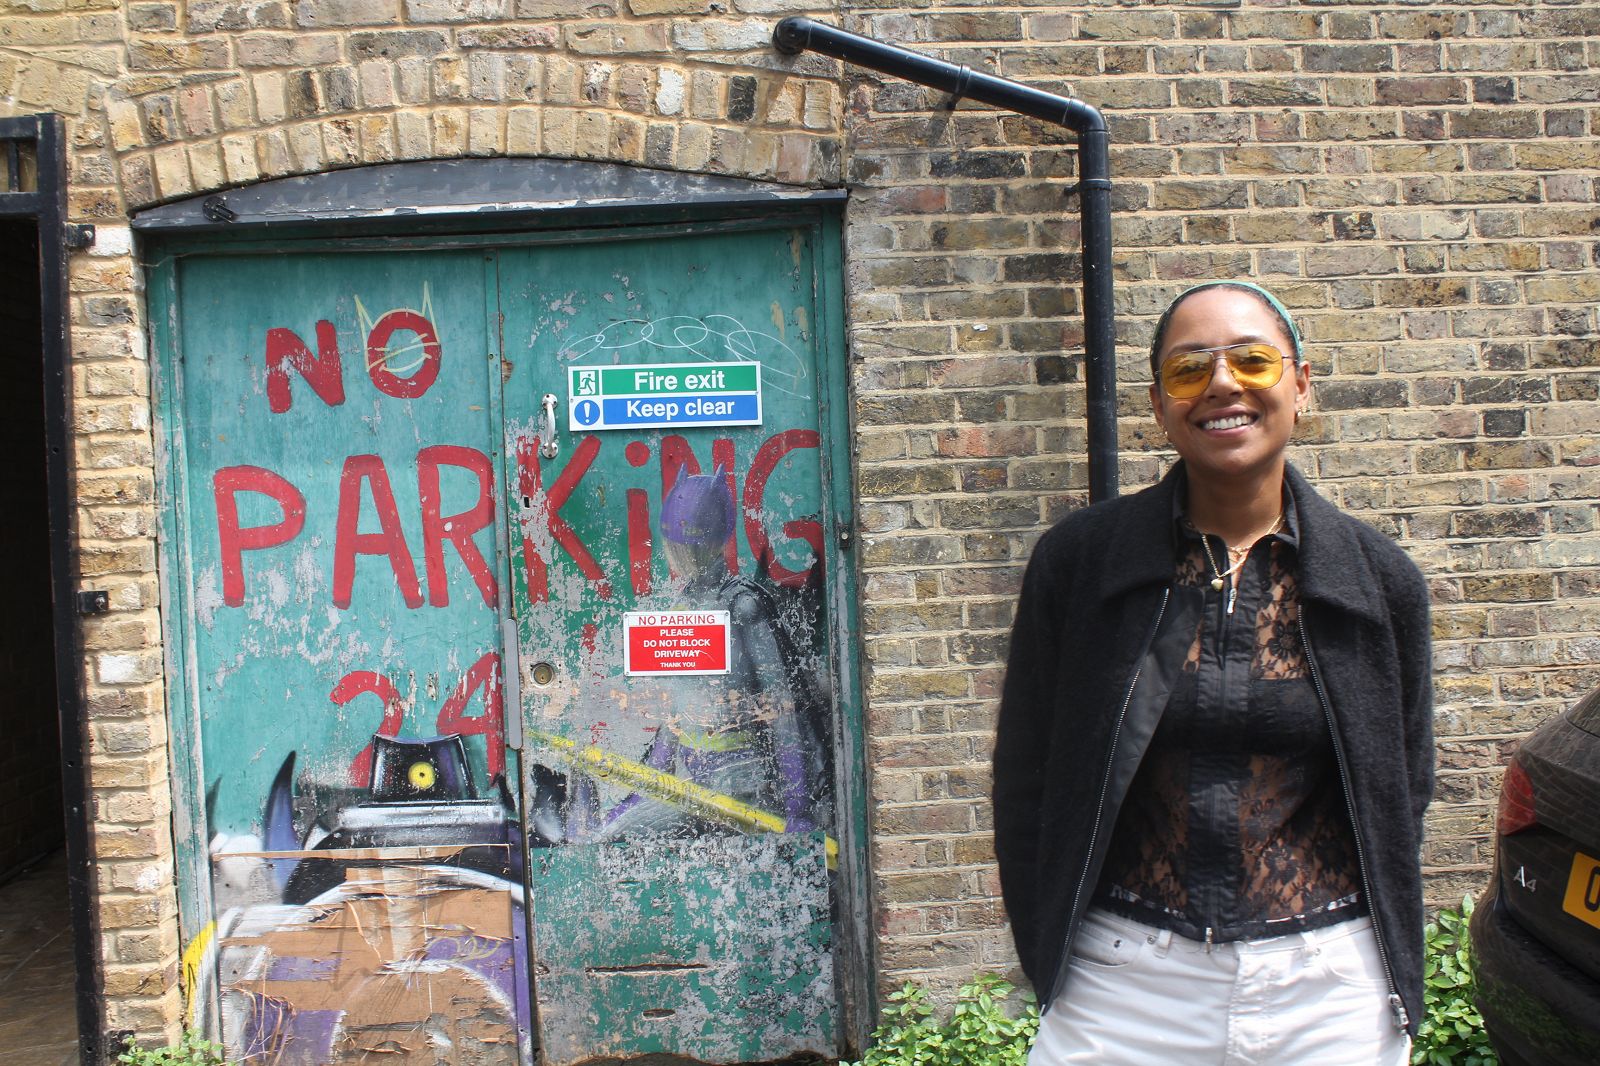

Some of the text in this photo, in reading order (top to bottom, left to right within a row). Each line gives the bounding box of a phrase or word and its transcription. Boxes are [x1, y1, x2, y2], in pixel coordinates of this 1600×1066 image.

[264, 309, 443, 414] NO
[634, 370, 726, 390] Fire exit
[626, 399, 735, 420] Keep clear
[638, 614, 716, 626] NO PARKING
[660, 628, 694, 636] PLEASE
[644, 640, 656, 648] DO
[680, 638, 710, 646] BLOCK
[654, 650, 700, 658] DRIVEWAY
[1513, 865, 1537, 893] A4
